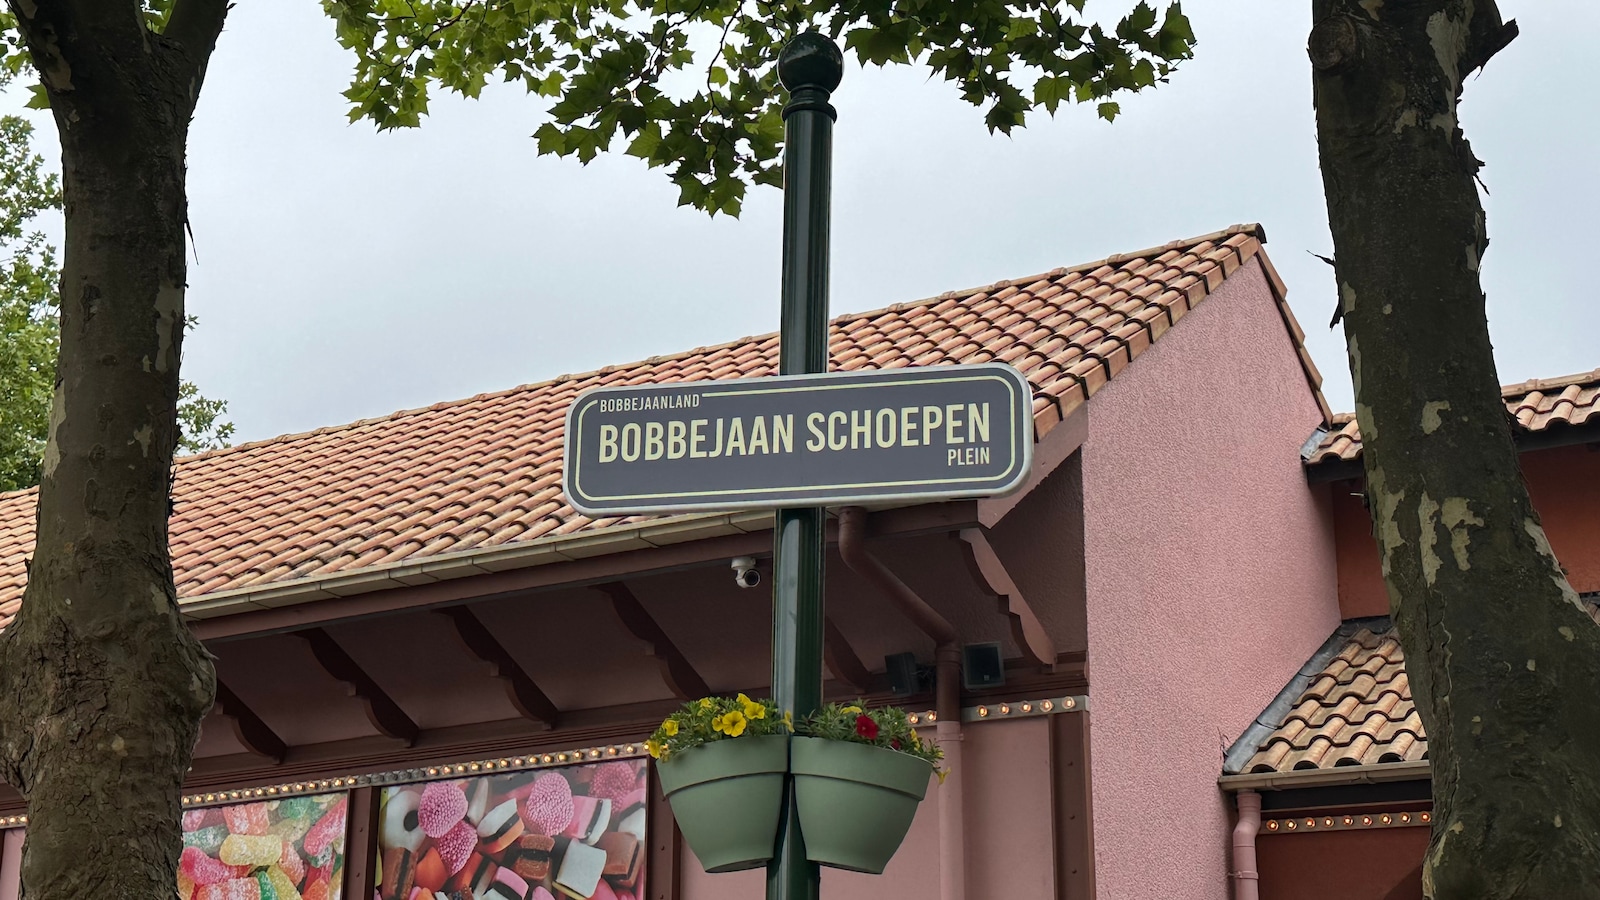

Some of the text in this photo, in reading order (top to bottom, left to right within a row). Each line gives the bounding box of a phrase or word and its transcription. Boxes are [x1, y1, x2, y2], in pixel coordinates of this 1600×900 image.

[600, 393, 700, 413] BOBBEJAANLAND
[598, 402, 990, 463] BOBBEJAAN SCHOEPEN
[947, 447, 990, 467] PLEIN
